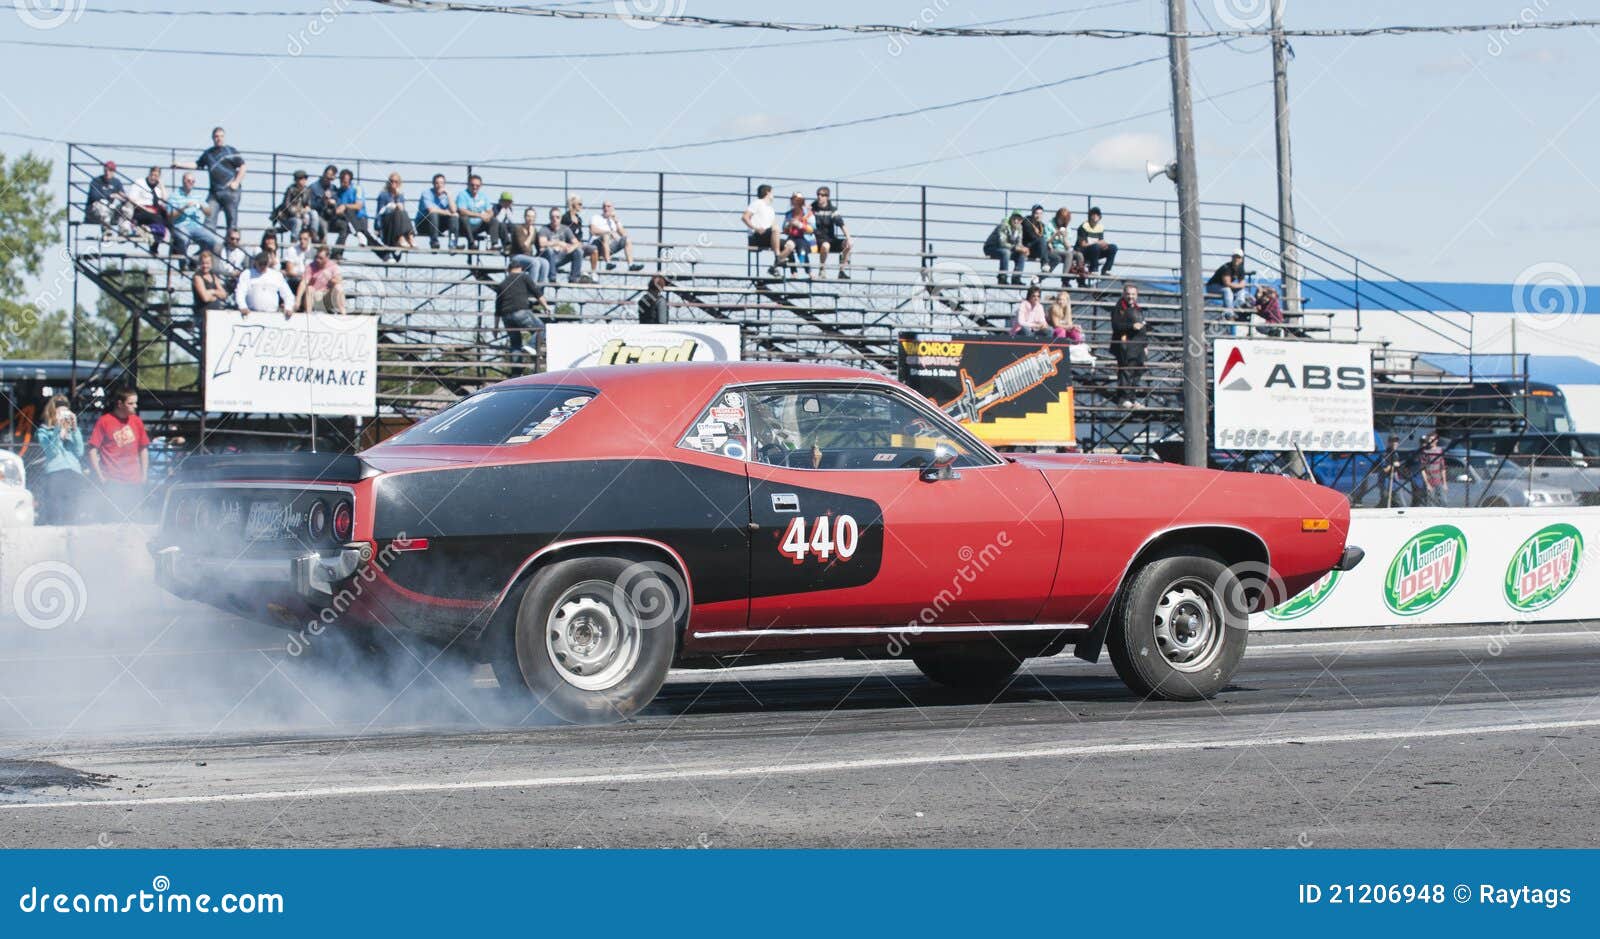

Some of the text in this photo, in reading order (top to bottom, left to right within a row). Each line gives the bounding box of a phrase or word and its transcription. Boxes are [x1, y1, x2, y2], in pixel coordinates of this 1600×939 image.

[213, 325, 370, 379] FEDERAL
[259, 364, 368, 386] PERFORMANCE
[1264, 364, 1366, 391] ABS
[779, 515, 858, 564] 440
[1521, 538, 1569, 574] Mountain
[1401, 540, 1452, 577] Mountain
